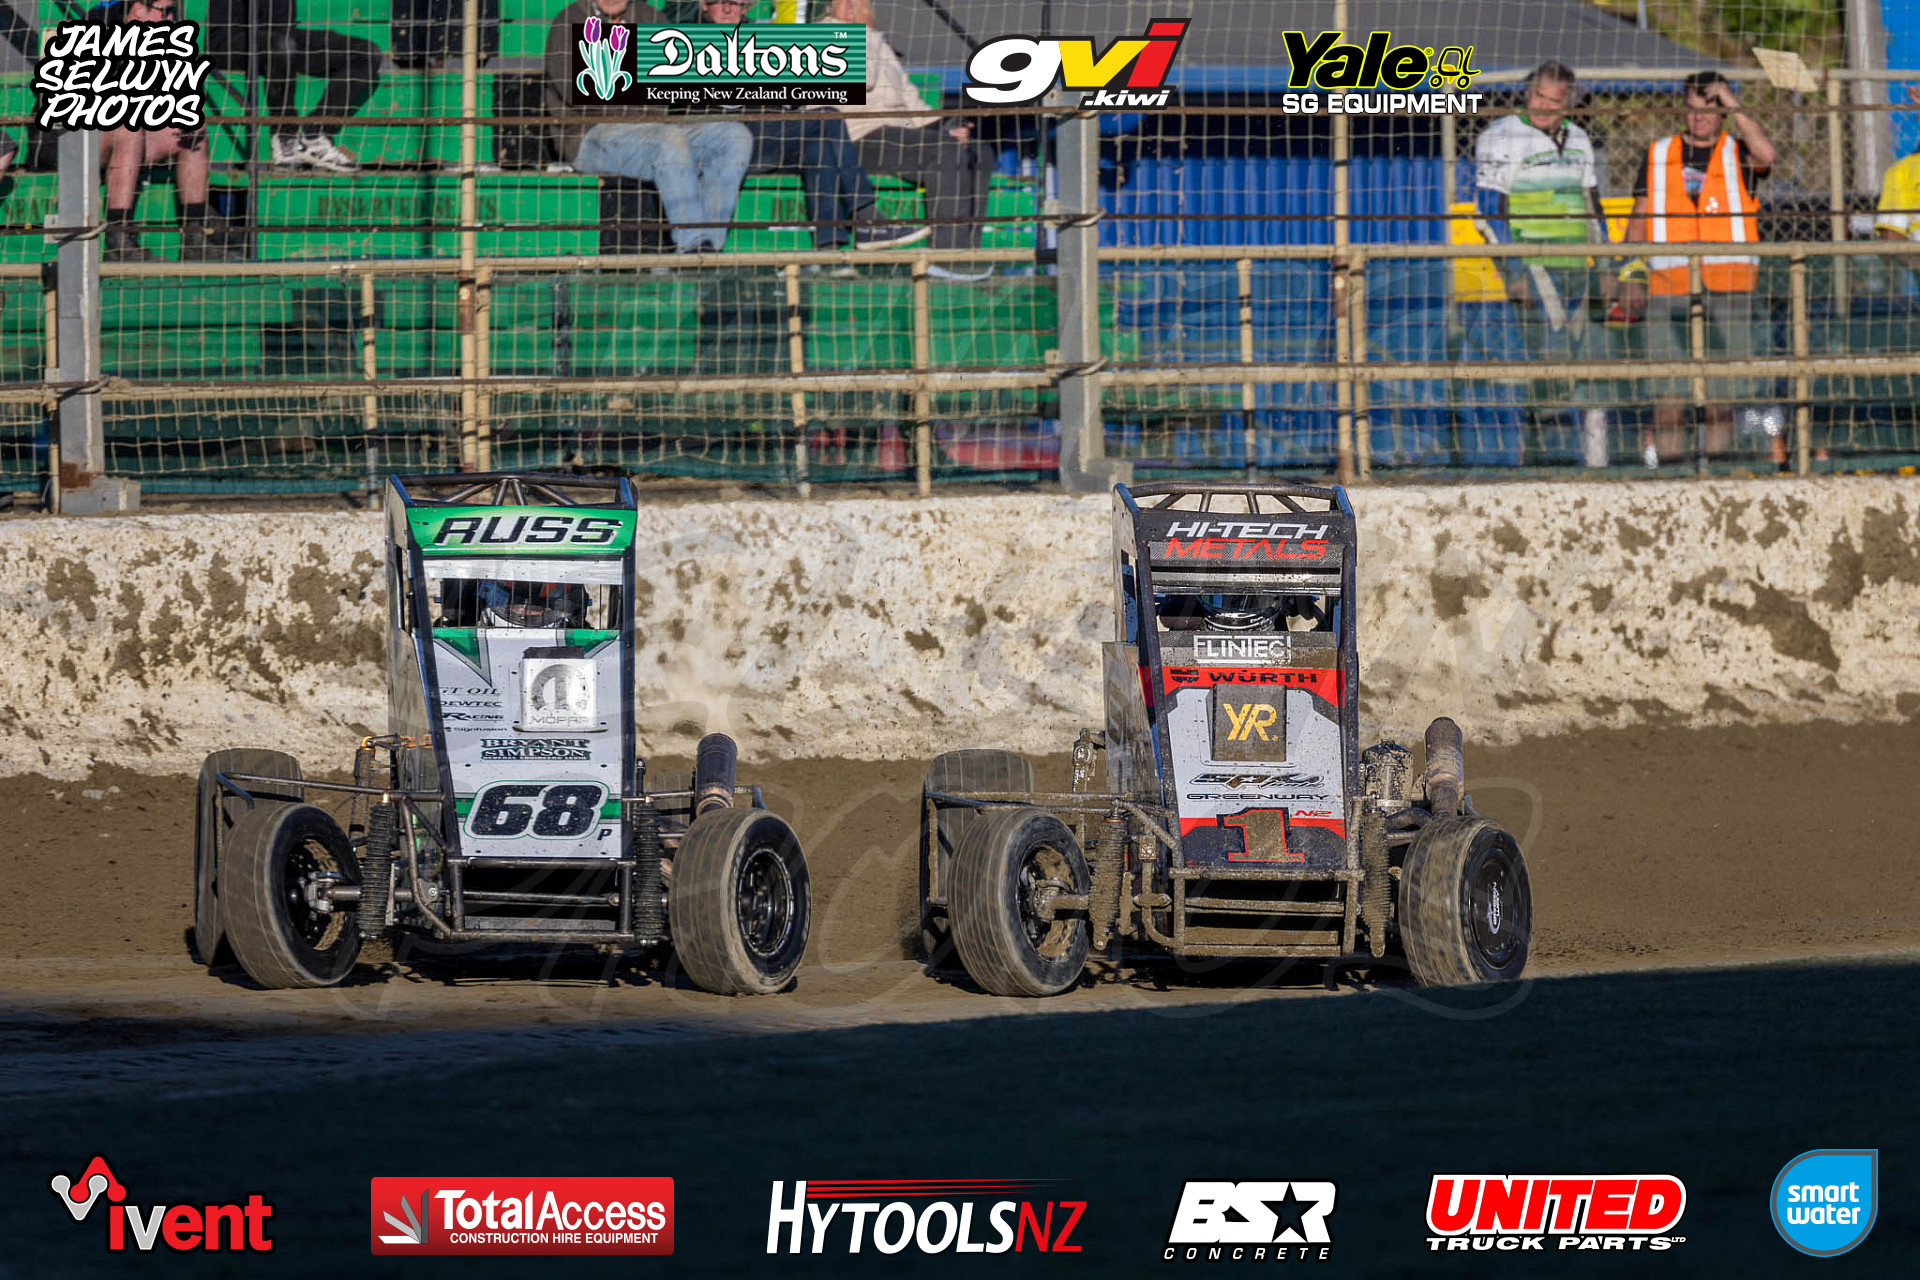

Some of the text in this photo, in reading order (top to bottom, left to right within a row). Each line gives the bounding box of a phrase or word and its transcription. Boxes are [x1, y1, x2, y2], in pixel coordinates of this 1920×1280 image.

[434, 515, 621, 545] RUSS
[1166, 521, 1329, 540] HI-TECH
[1165, 538, 1329, 560] METALS
[1208, 671, 1316, 683] WÜRTH
[532, 716, 588, 724] MOPAR
[1222, 704, 1278, 741] YR
[484, 748, 585, 757] SIMPSON
[486, 739, 585, 748] BRYANT
[470, 784, 603, 836] 68
[597, 828, 612, 840] P
[1217, 807, 1305, 863] 1
